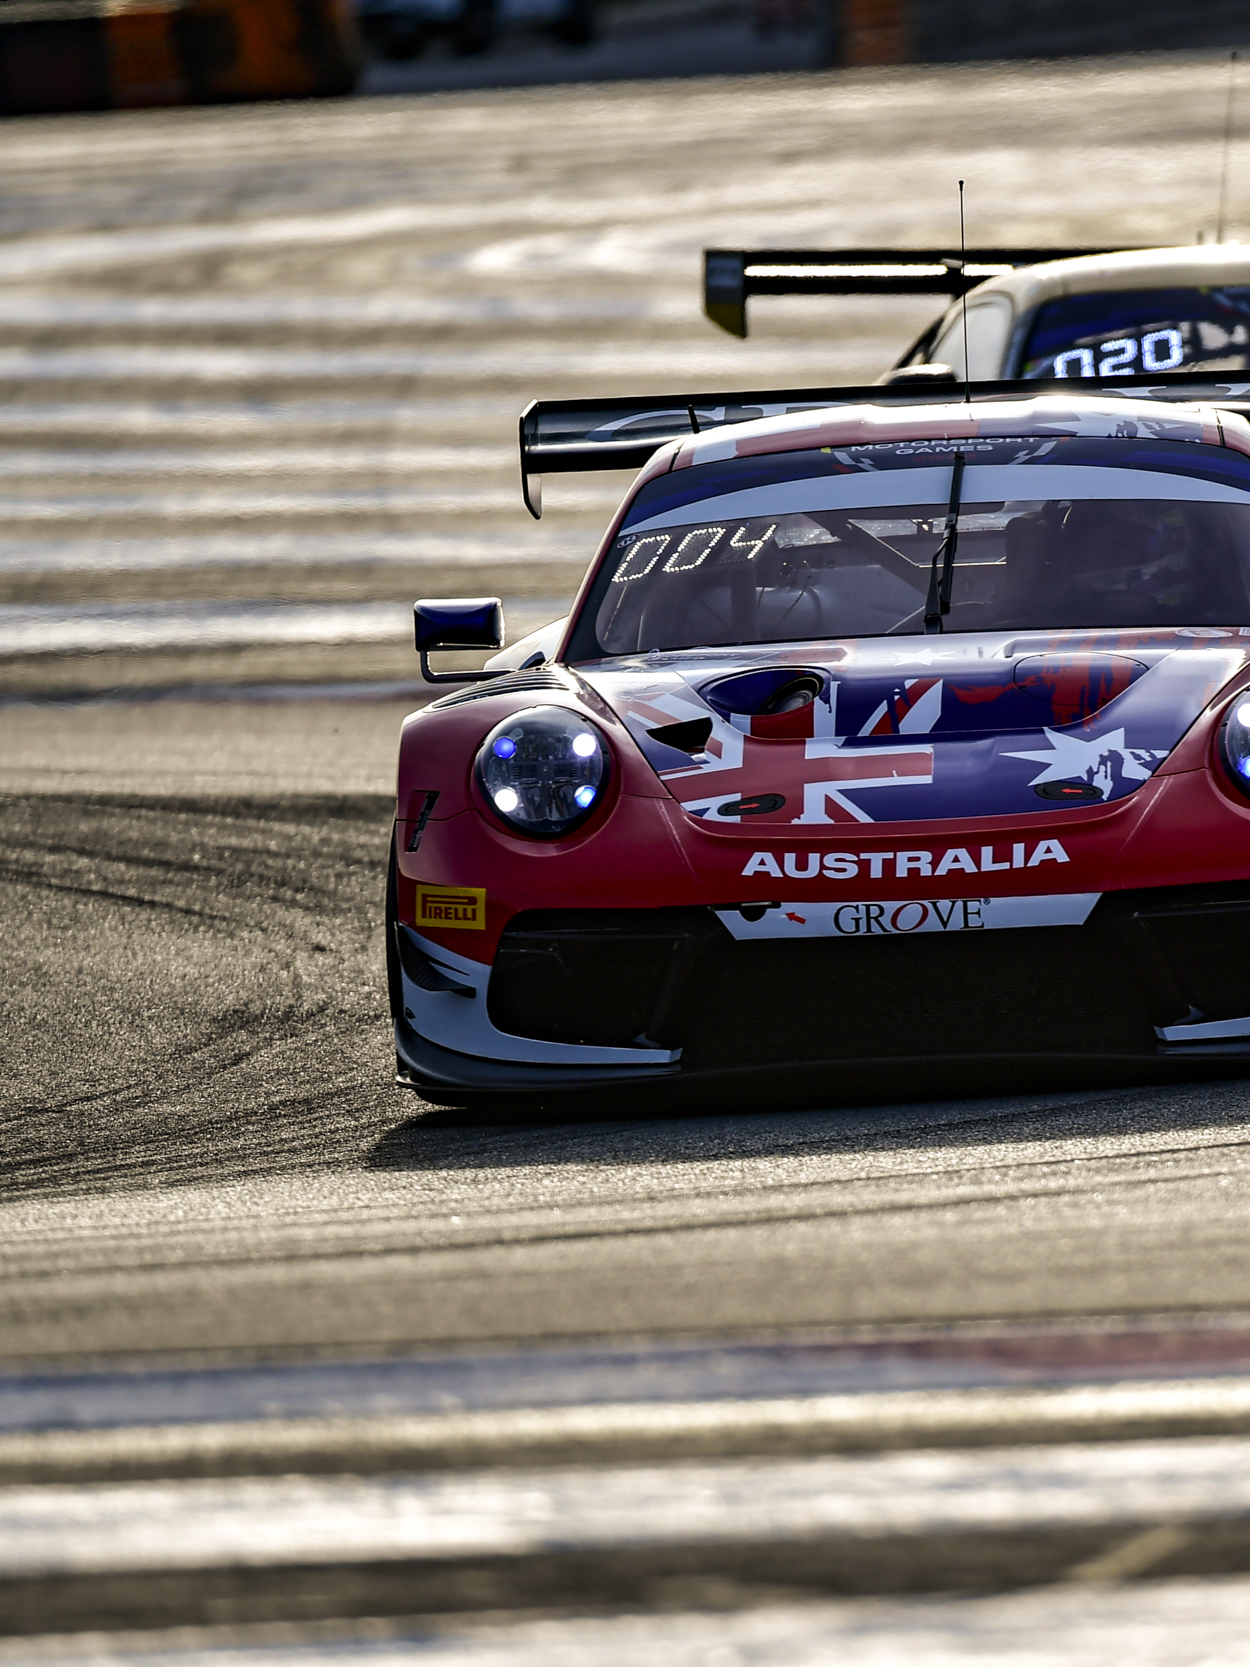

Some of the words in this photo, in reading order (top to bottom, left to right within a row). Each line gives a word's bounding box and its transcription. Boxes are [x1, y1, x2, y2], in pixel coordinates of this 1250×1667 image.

[1053, 329, 1183, 378] 020
[851, 437, 1040, 452] MOTORSPORT
[895, 445, 993, 455] GAMES
[611, 524, 777, 583] 004
[741, 839, 1070, 879] AUSTRALIA
[421, 893, 478, 921] PIRELLI
